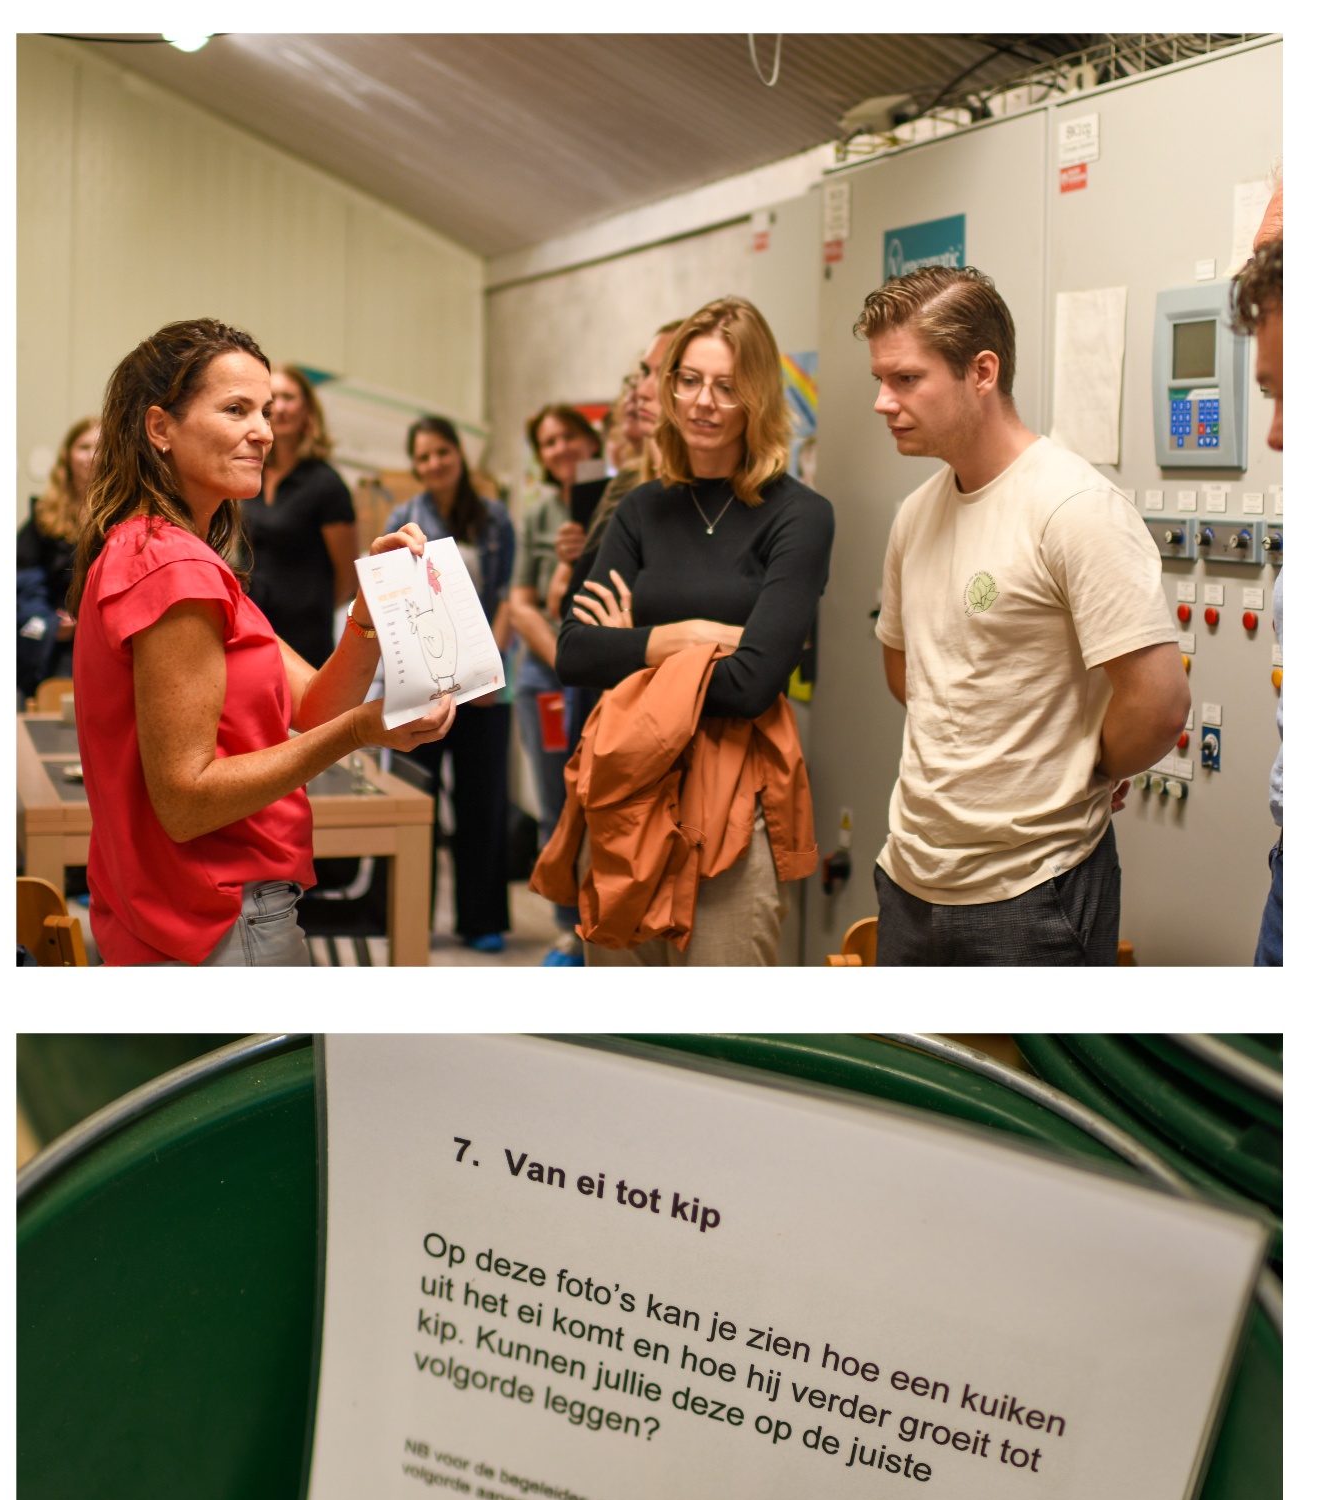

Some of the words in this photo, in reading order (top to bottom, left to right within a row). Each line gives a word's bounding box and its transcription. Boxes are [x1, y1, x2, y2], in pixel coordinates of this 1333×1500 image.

[453, 1136, 479, 1167] 7.
[504, 1149, 566, 1188] Van
[577, 1173, 605, 1199] ei
[616, 1180, 661, 1214] tot
[671, 1192, 721, 1233] kip
[421, 1275, 454, 1301] uit
[464, 1282, 509, 1317] het
[517, 1303, 543, 1326] ei
[553, 1307, 624, 1351] komt
[633, 1338, 669, 1364] en
[681, 1345, 736, 1382] hoe
[747, 1364, 782, 1402] hij
[791, 1382, 892, 1428] verder
[898, 1415, 991, 1458] groeit
[1000, 1439, 1042, 1473] tot
[423, 1232, 466, 1268] Op
[475, 1249, 546, 1287] deze
[646, 1294, 700, 1331] kan
[707, 1312, 737, 1343] je
[746, 1327, 811, 1363] zien
[822, 1344, 880, 1383] hoe
[890, 1370, 950, 1403] een
[961, 1384, 1066, 1436] kuiken
[414, 1352, 535, 1404] volgorde
[544, 1386, 660, 1442] leggen?
[417, 1309, 464, 1344] kip.
[476, 1325, 585, 1380] Kunnen
[593, 1362, 662, 1402] jullie
[672, 1387, 744, 1426] deze
[754, 1415, 792, 1445] op
[802, 1425, 840, 1455] de
[845, 1437, 933, 1482] juiste
[402, 1462, 471, 1495] volgorde
[404, 1438, 430, 1458] NB
[434, 1450, 470, 1471] voor
[474, 1463, 495, 1479] de
